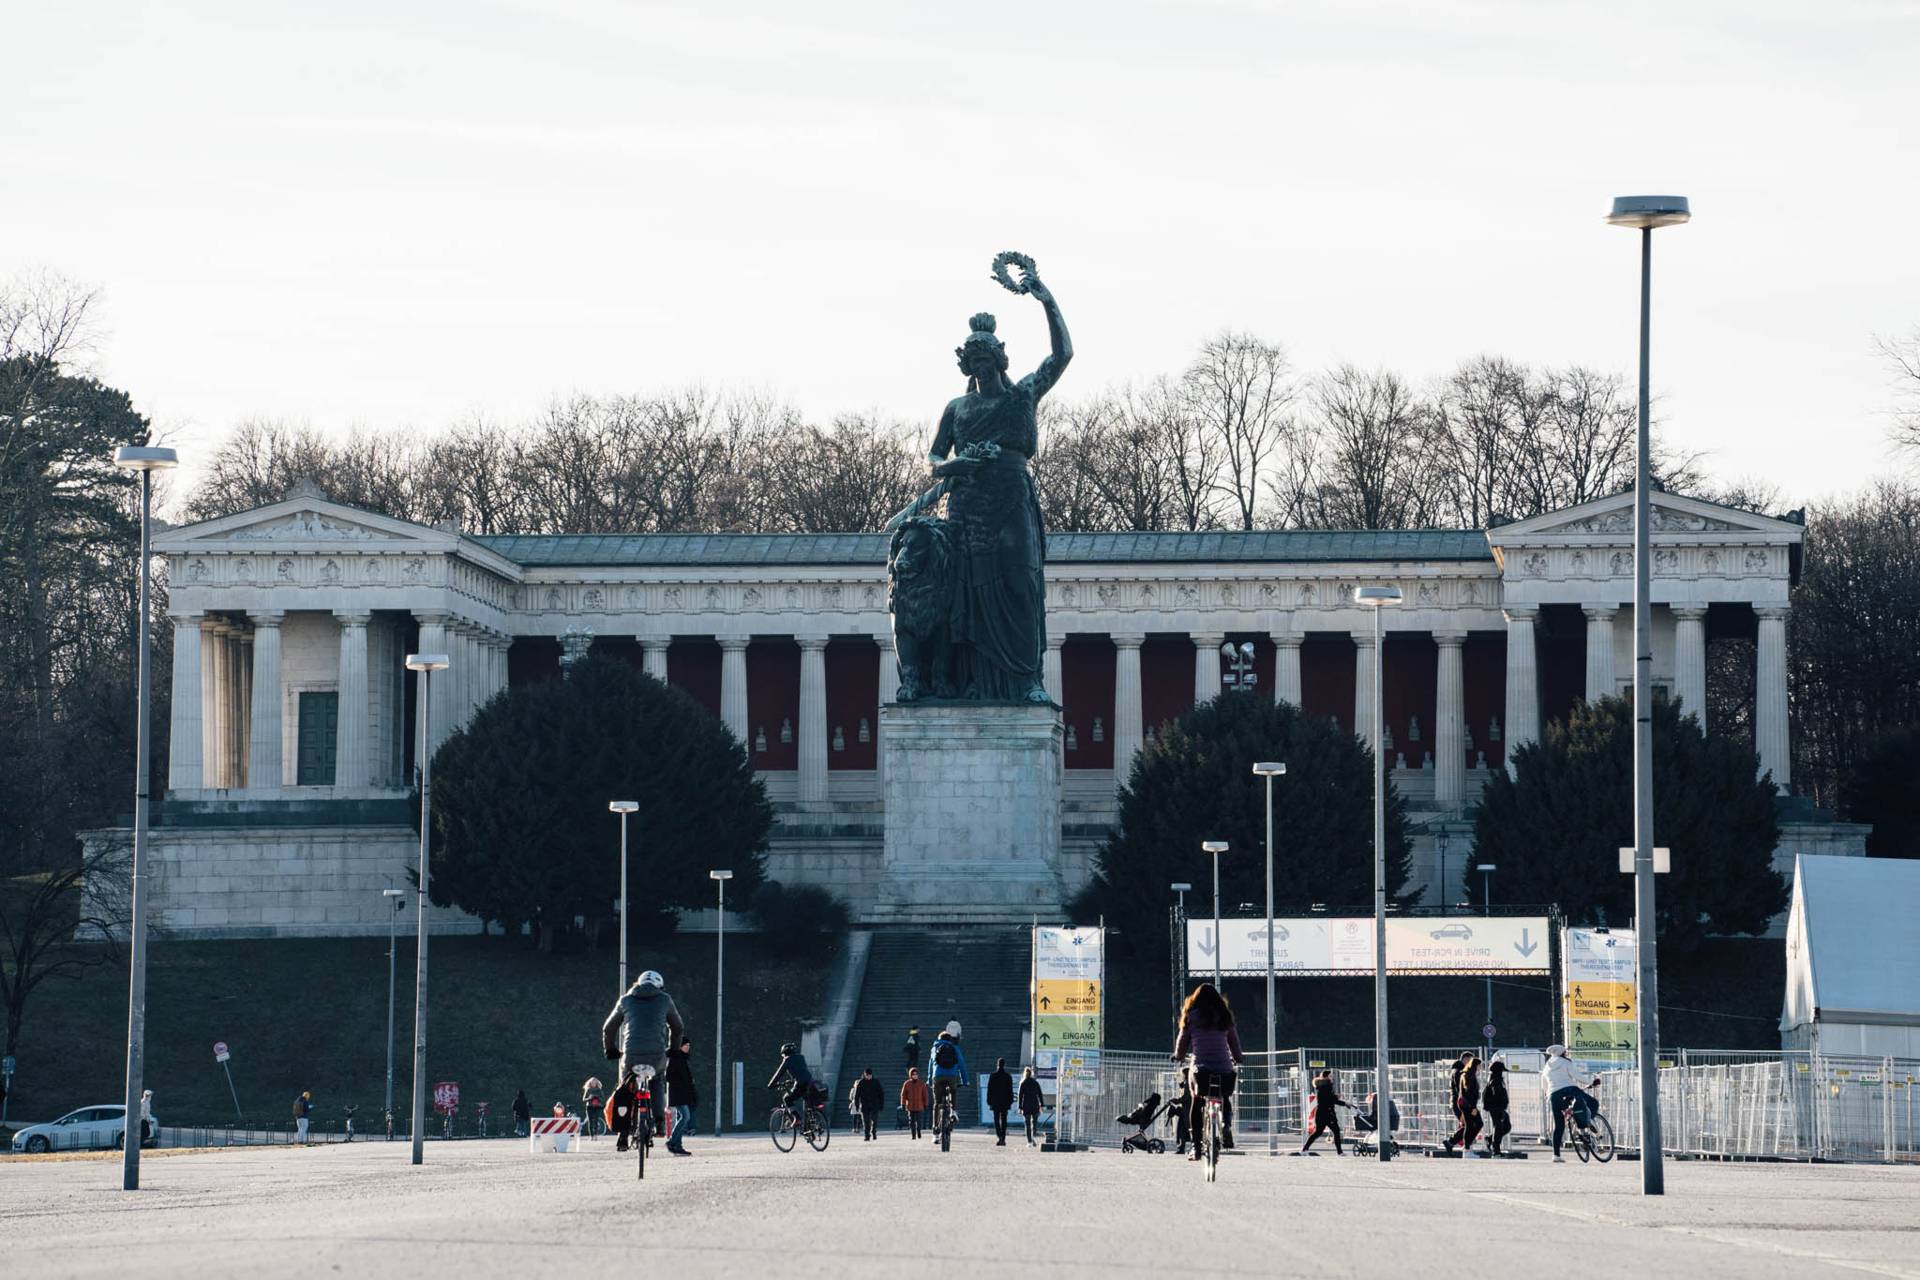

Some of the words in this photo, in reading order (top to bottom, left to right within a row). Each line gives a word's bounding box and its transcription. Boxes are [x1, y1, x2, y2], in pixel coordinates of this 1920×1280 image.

[1065, 997, 1096, 1005] EINGANG
[1574, 1000, 1610, 1009] EINGANG
[1062, 1032, 1096, 1040] EINGANG
[1575, 1040, 1611, 1049] EINGANG
